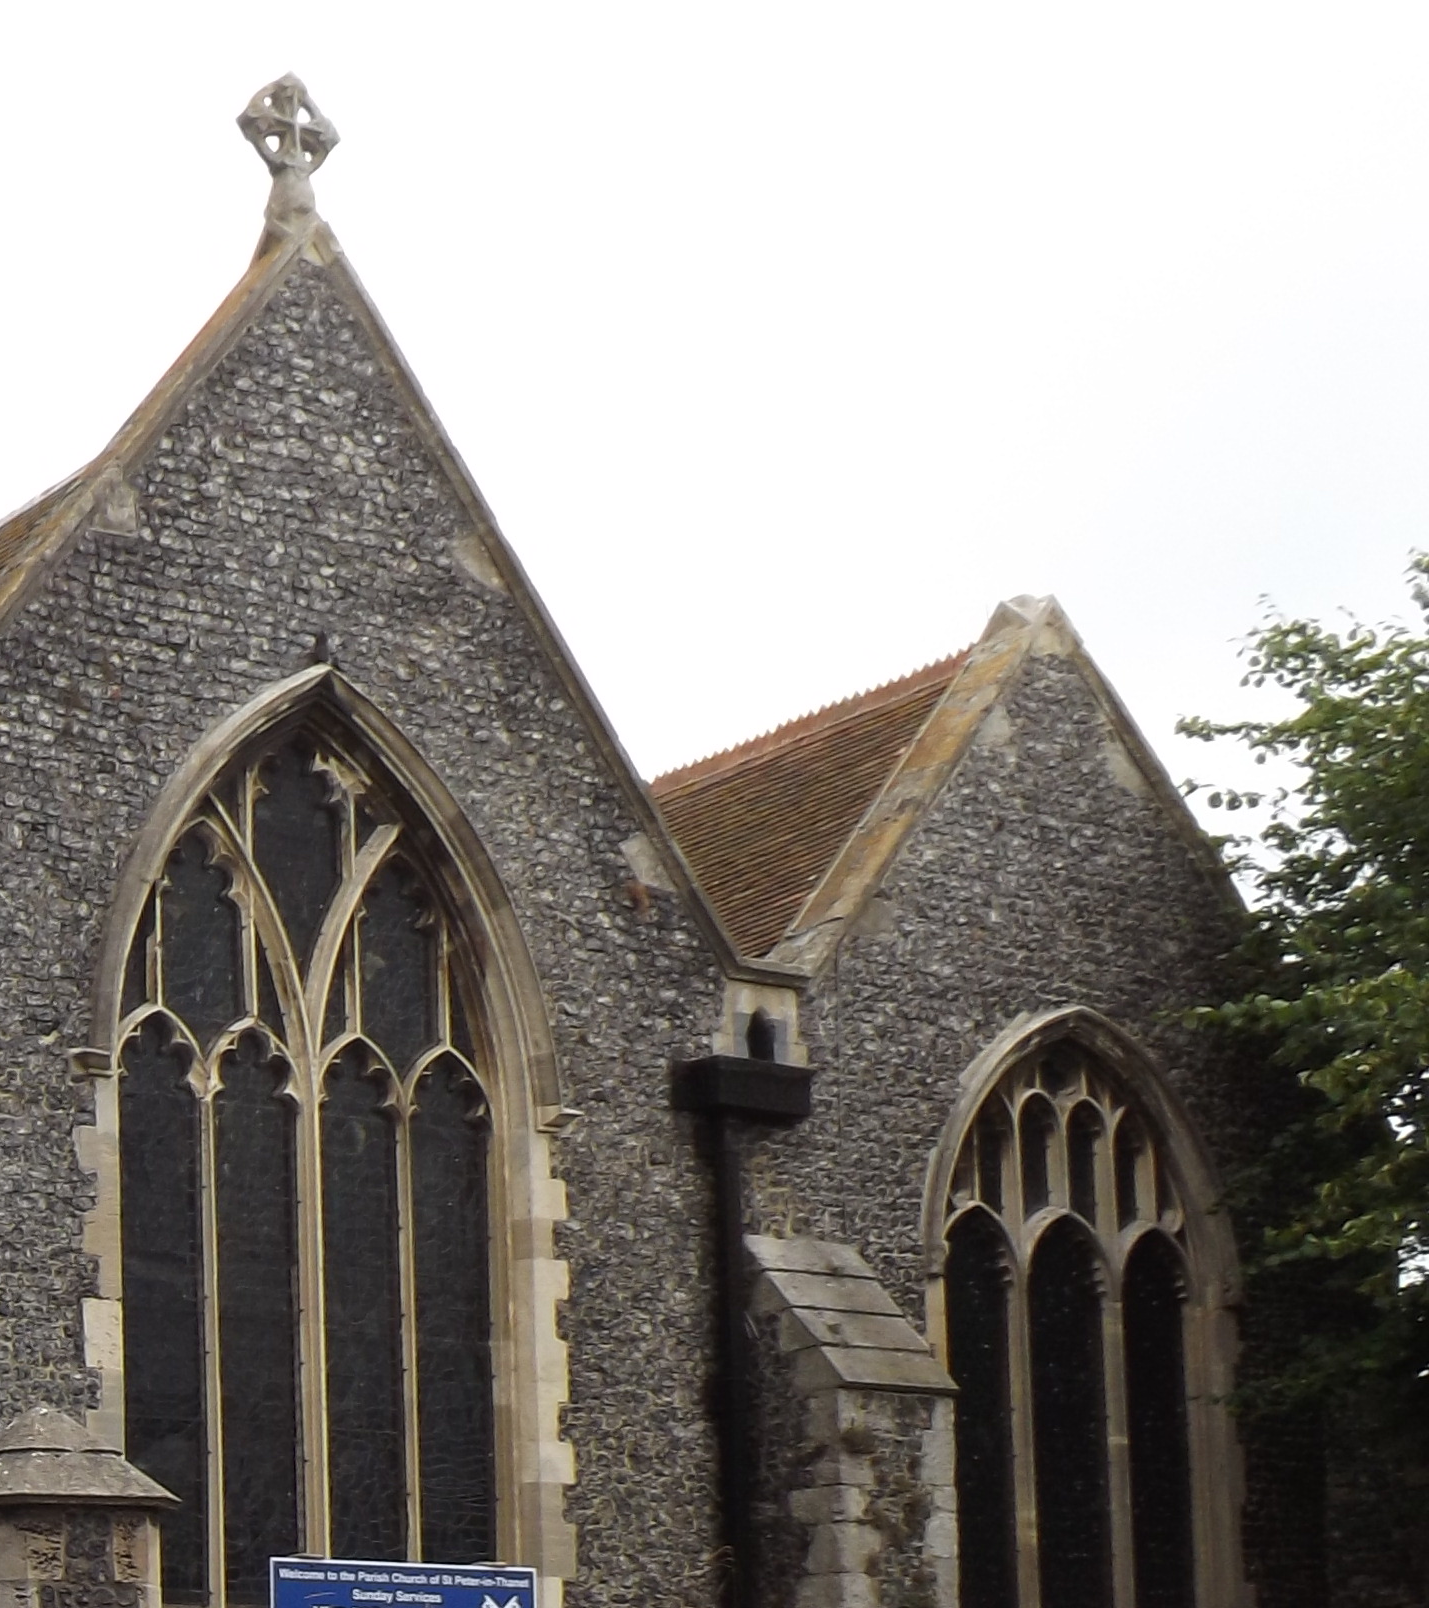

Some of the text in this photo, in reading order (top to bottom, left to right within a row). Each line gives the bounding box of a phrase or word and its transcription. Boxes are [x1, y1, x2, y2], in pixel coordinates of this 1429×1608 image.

[279, 1568, 325, 1580] Welcome
[327, 1571, 338, 1580] to
[340, 1571, 356, 1581] the
[358, 1571, 390, 1582] Parish
[392, 1572, 429, 1584] Church
[429, 1574, 440, 1585] of
[442, 1575, 453, 1585] St
[352, 1588, 442, 1604] Sunday Services
